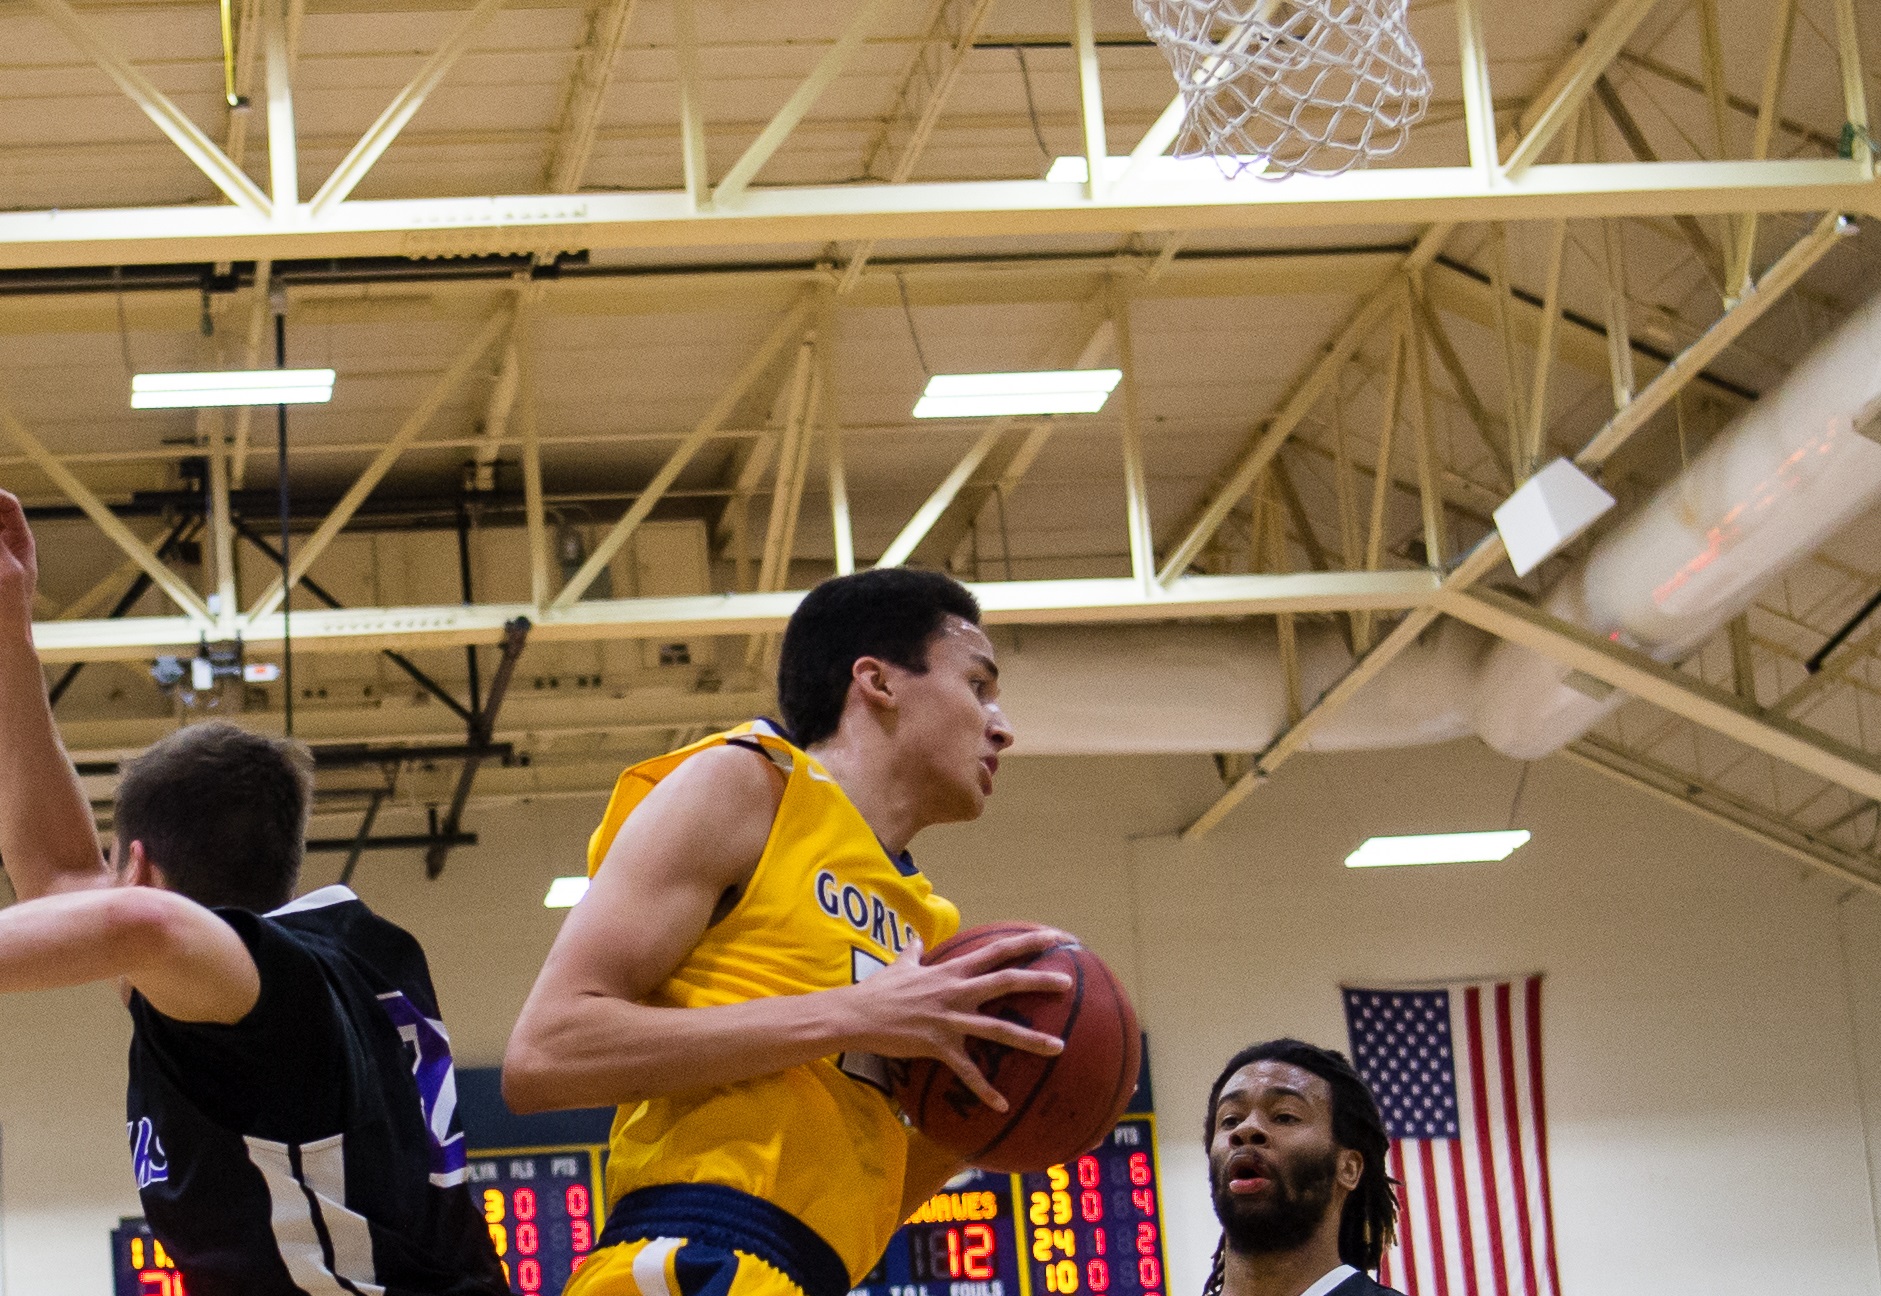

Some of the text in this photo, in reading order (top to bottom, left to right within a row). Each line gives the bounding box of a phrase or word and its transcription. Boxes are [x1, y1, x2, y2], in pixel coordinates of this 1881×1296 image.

[1077, 1155, 1100, 1189] 0
[1129, 1152, 1152, 1186] 6
[512, 1187, 538, 1222] 0
[565, 1183, 590, 1219] 0
[1029, 1188, 1155, 1226] 23 0 4
[515, 1221, 540, 1256] 0
[570, 1218, 592, 1253] 3
[947, 1224, 995, 1279] 12
[1033, 1221, 1157, 1262] 24 1 2
[517, 1257, 542, 1293] 0
[1045, 1255, 1161, 1294] 10 0 0
